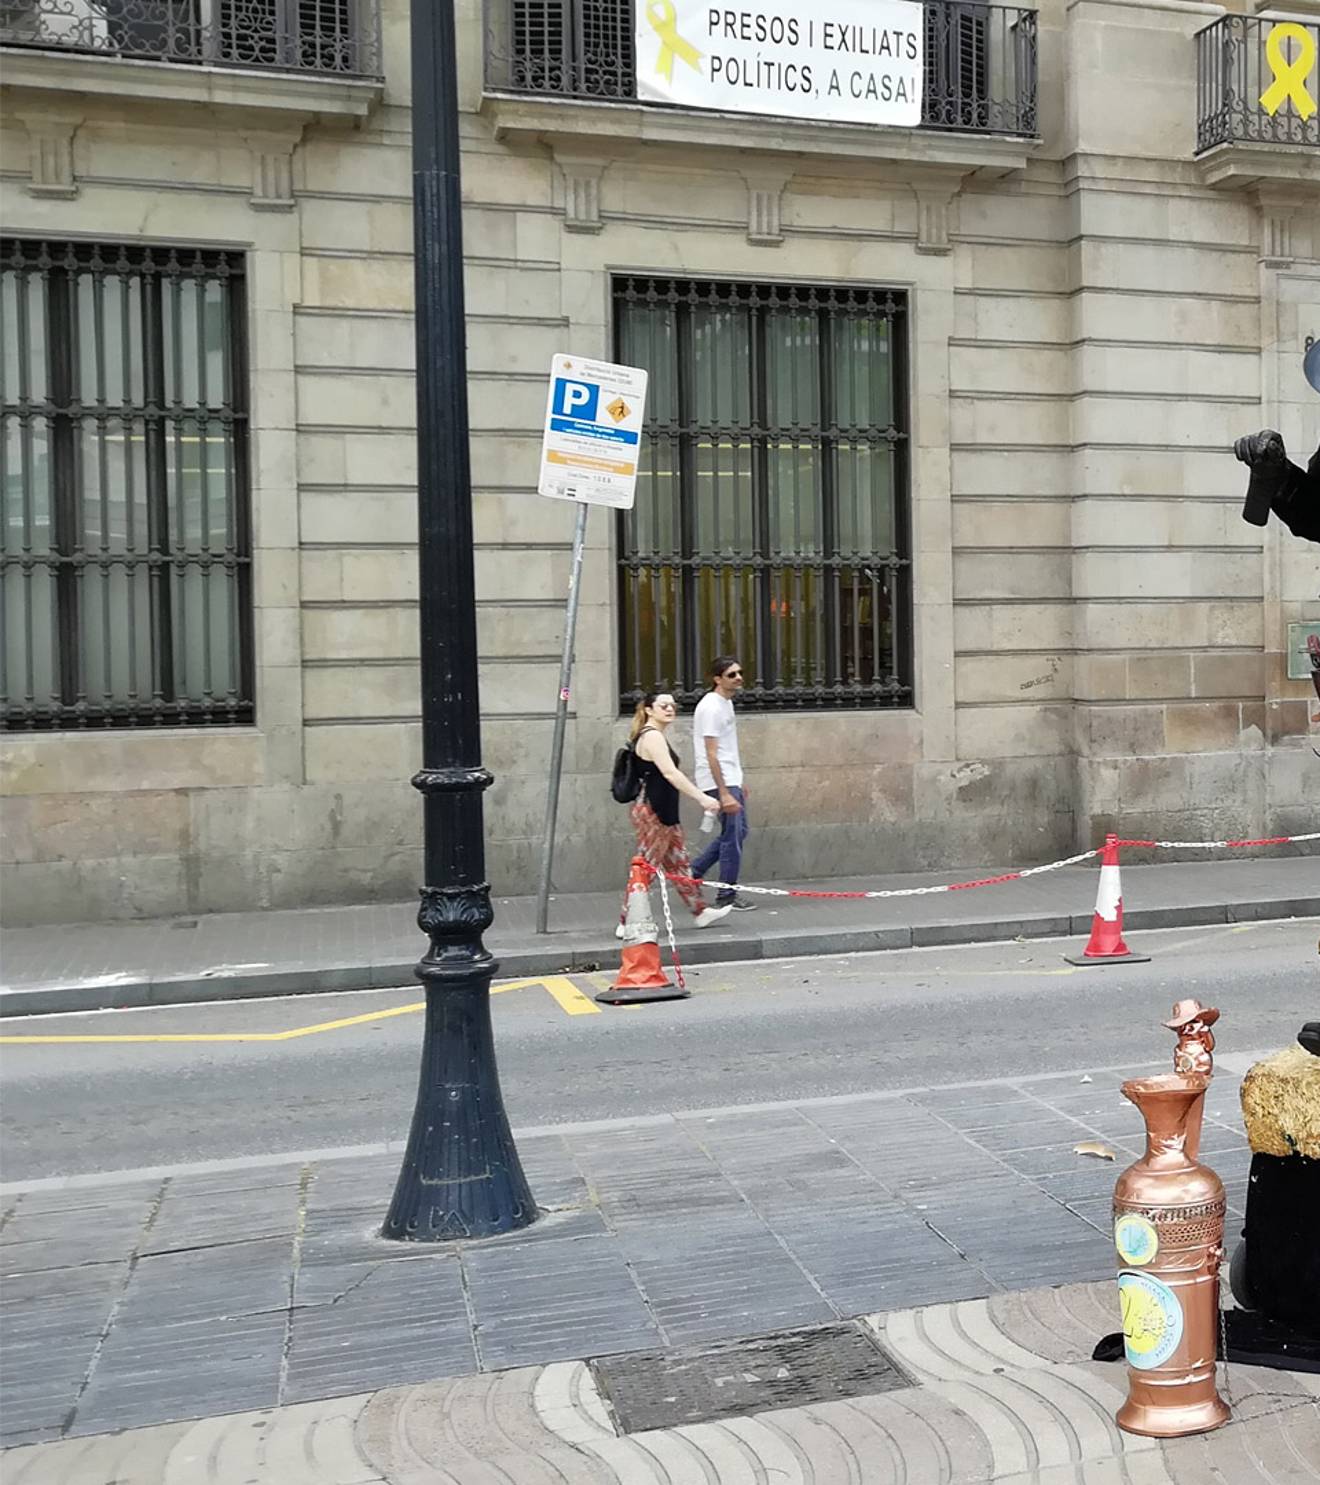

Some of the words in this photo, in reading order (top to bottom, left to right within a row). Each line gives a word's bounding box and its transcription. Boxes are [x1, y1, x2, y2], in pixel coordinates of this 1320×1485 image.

[708, 8, 800, 46] PRESOS
[809, 20, 814, 48] I
[823, 22, 918, 60] EXILIATS
[710, 52, 820, 99] POLÍTICS,
[827, 69, 842, 97] A
[850, 71, 916, 104] CASA!
[562, 382, 590, 415] P
